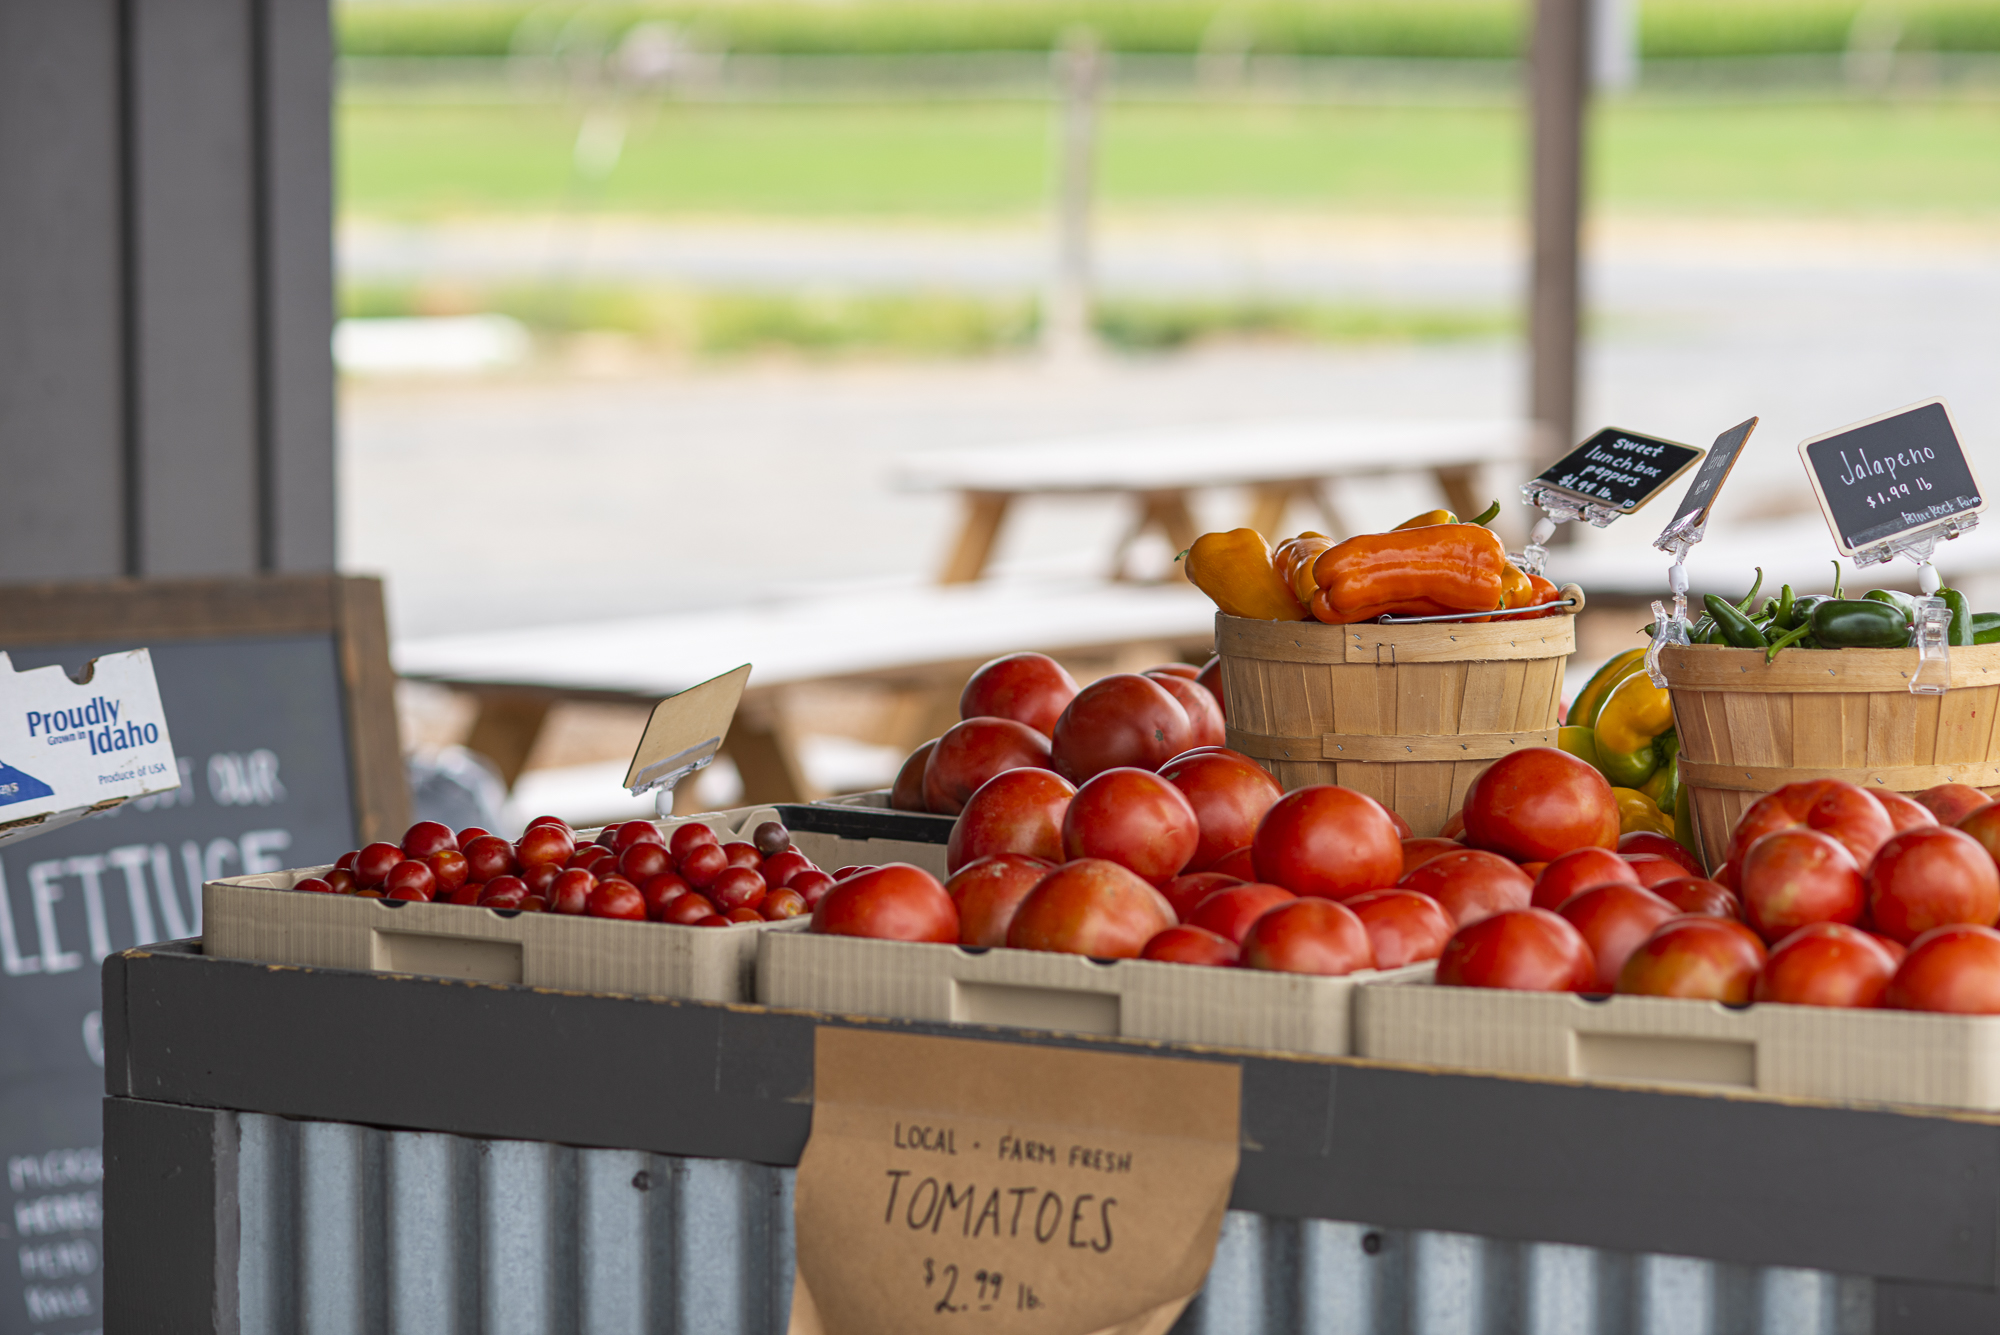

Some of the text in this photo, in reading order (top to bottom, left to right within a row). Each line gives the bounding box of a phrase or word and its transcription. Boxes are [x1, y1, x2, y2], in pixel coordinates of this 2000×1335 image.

[1613, 438, 1665, 457] sweet
[1579, 465, 1641, 488] peppers
[1840, 447, 1935, 486] Jalapeno
[1866, 477, 1933, 509] $1.99 lb
[26, 696, 120, 737] Proudly
[47, 720, 159, 756] Grown in Idaho
[98, 763, 168, 785] Produce of USA
[893, 1122, 1134, 1173] LOCAL FARM FRESH
[884, 1169, 1119, 1254] TOMATOES
